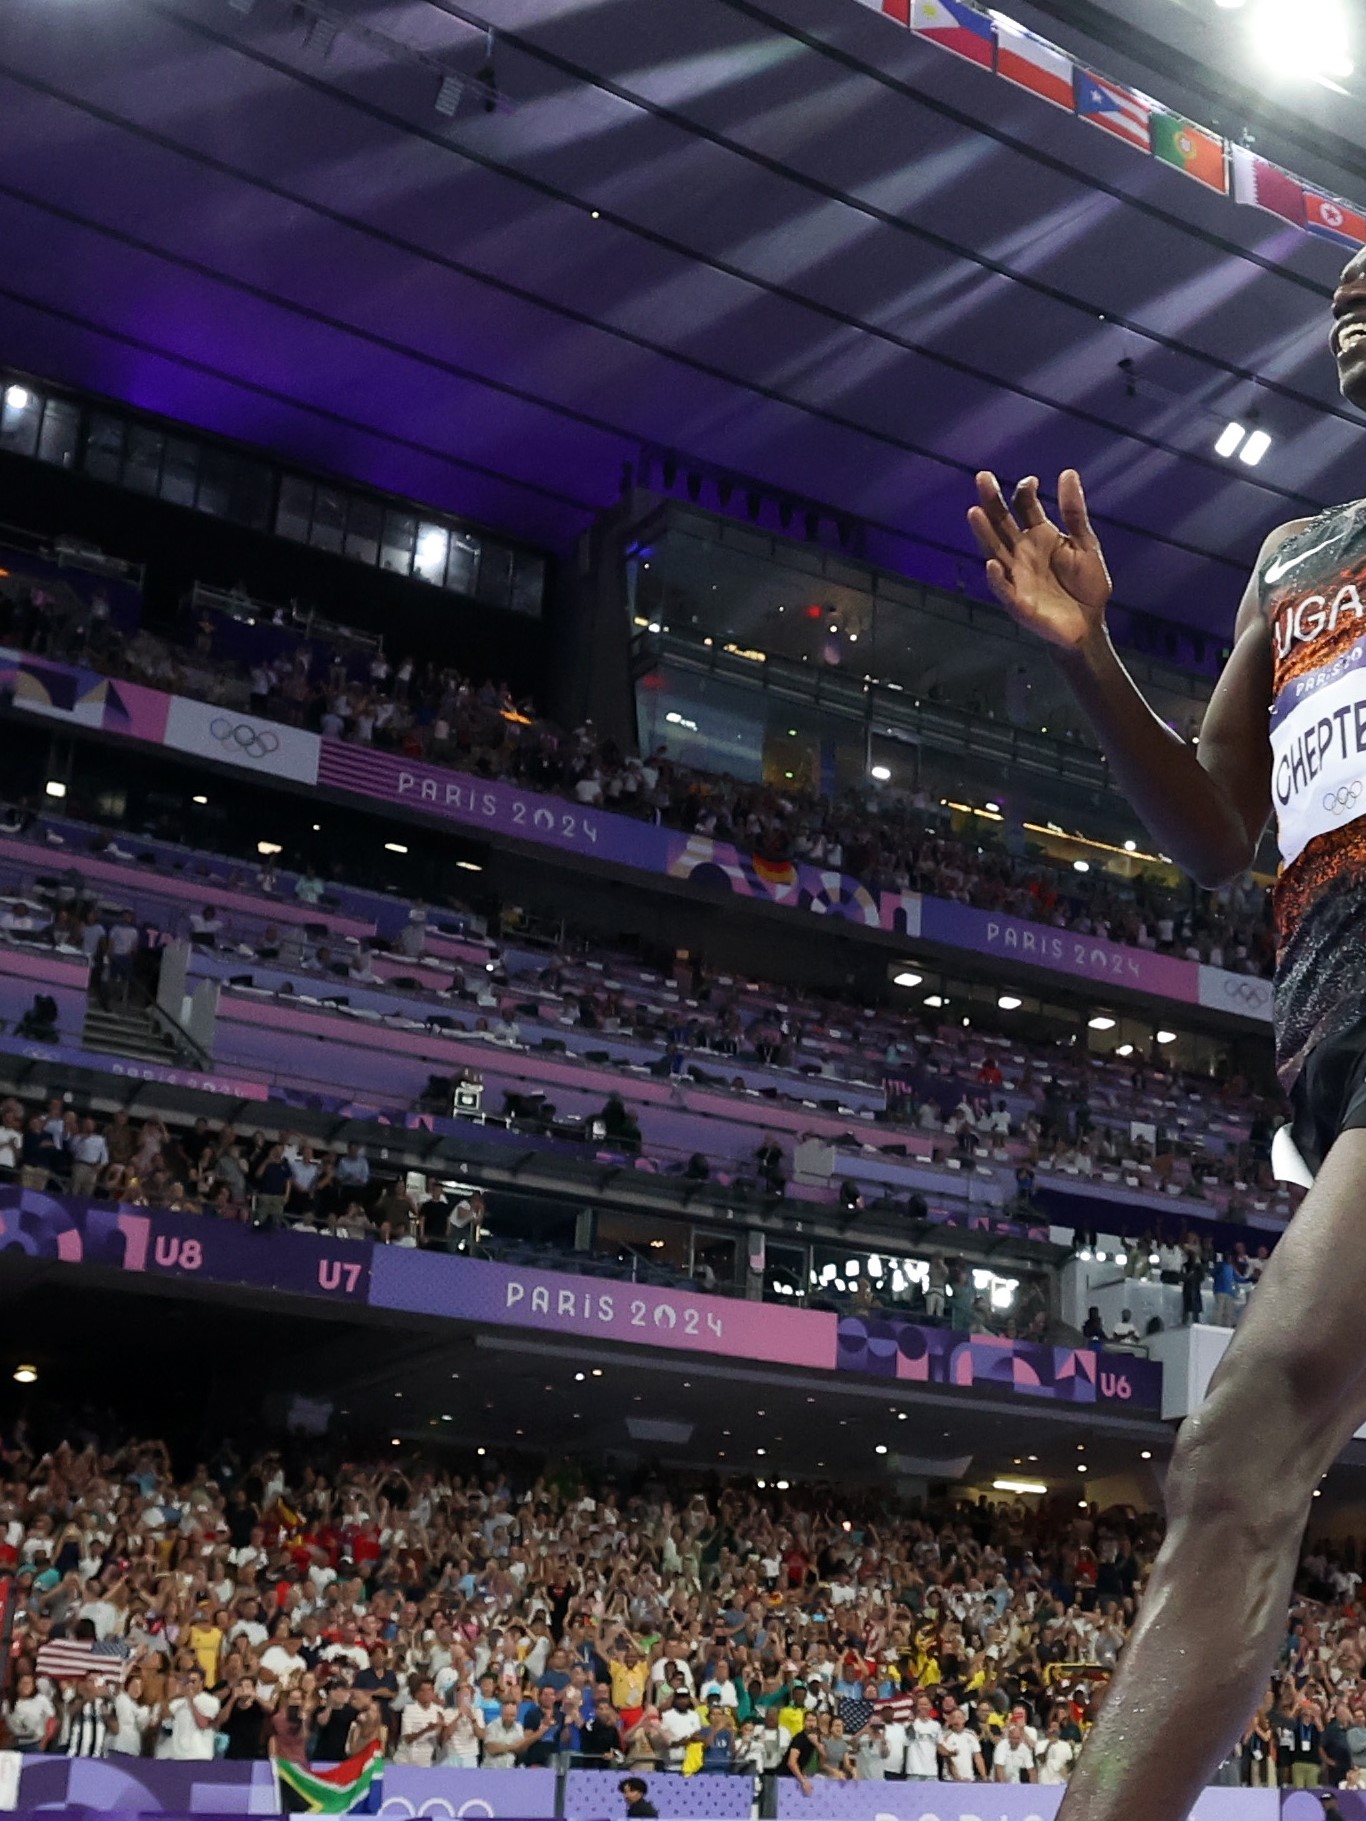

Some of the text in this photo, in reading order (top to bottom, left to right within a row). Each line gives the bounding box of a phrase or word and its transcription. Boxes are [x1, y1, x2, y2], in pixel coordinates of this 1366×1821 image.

[399, 772, 598, 842] PARIS 2024
[987, 922, 1140, 978] PARIS 2024
[155, 1235, 203, 1270] U8
[318, 1259, 362, 1292] U7
[506, 1282, 722, 1337] PARIS 2024
[1101, 1372, 1132, 1400] U6
